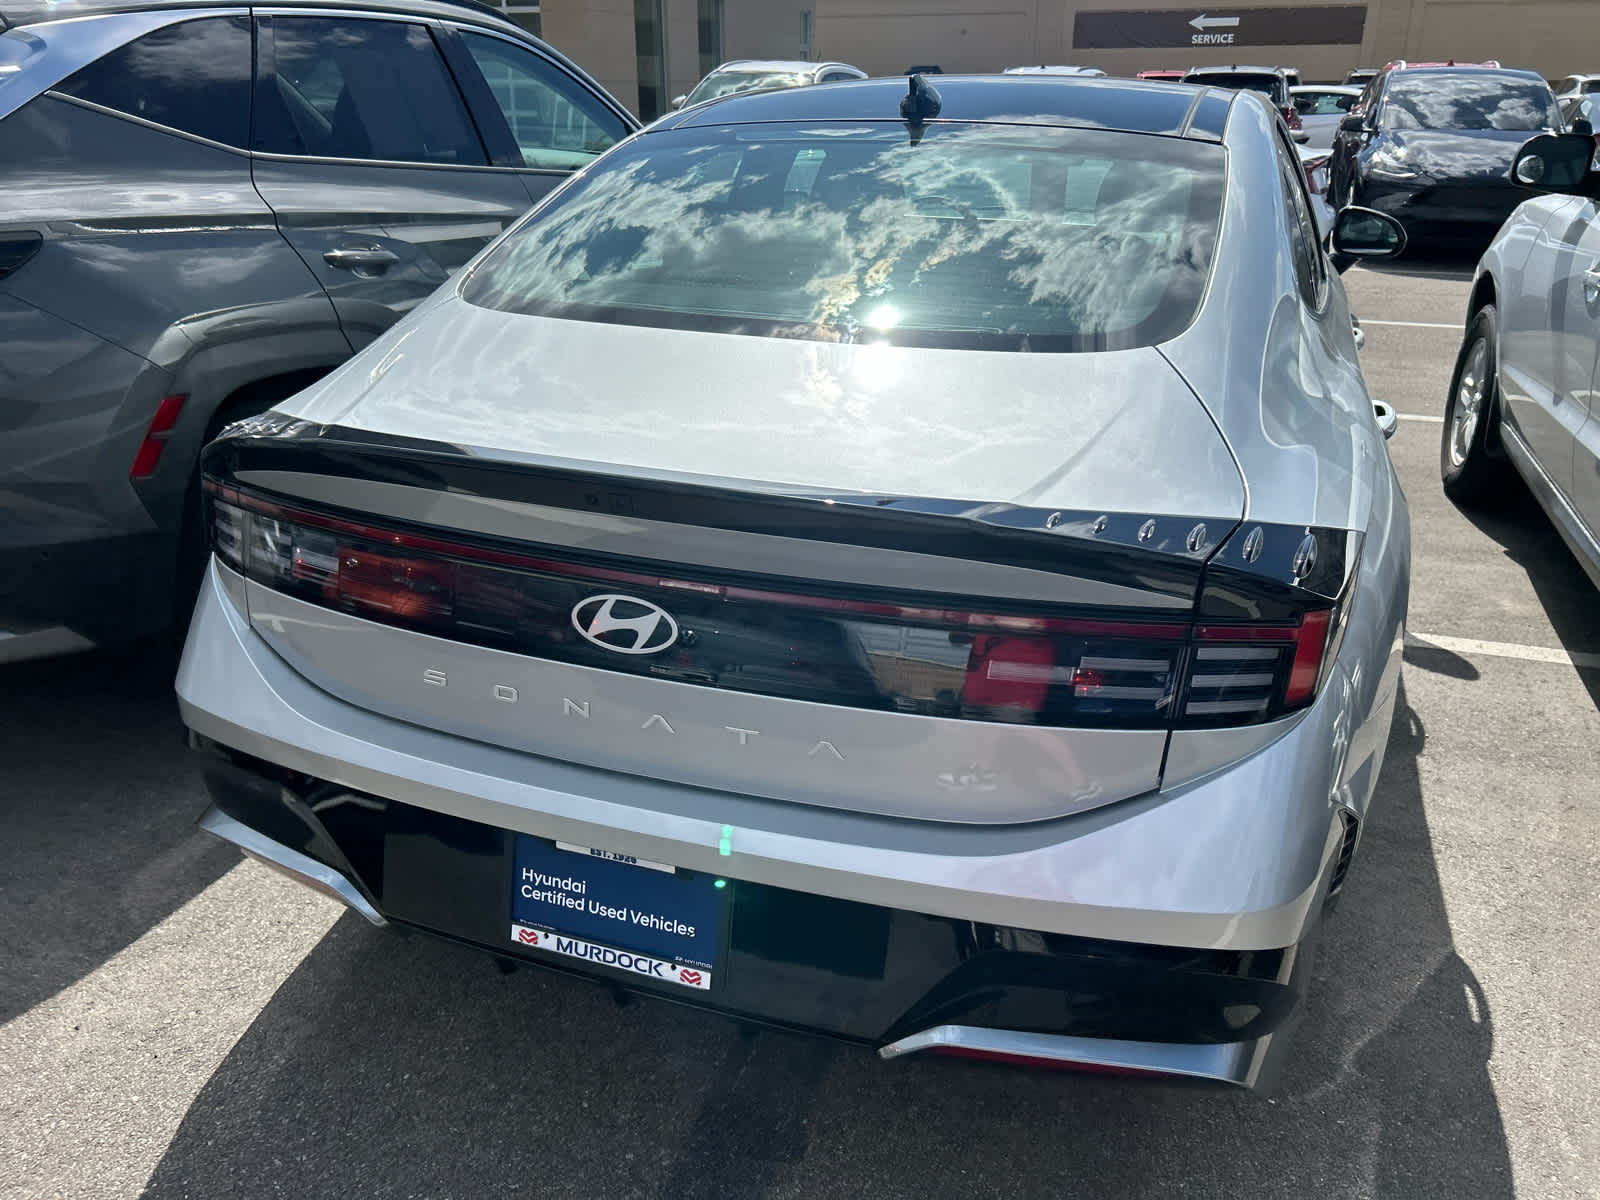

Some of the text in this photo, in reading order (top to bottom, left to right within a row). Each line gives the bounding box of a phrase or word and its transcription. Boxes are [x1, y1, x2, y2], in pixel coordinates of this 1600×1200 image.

[1191, 34, 1234, 44] SERVICE
[423, 668, 846, 761] SONATA
[522, 867, 586, 894] Hyundai
[521, 884, 696, 937] Certified Used Vehicles
[556, 936, 664, 977] MURDOCK
